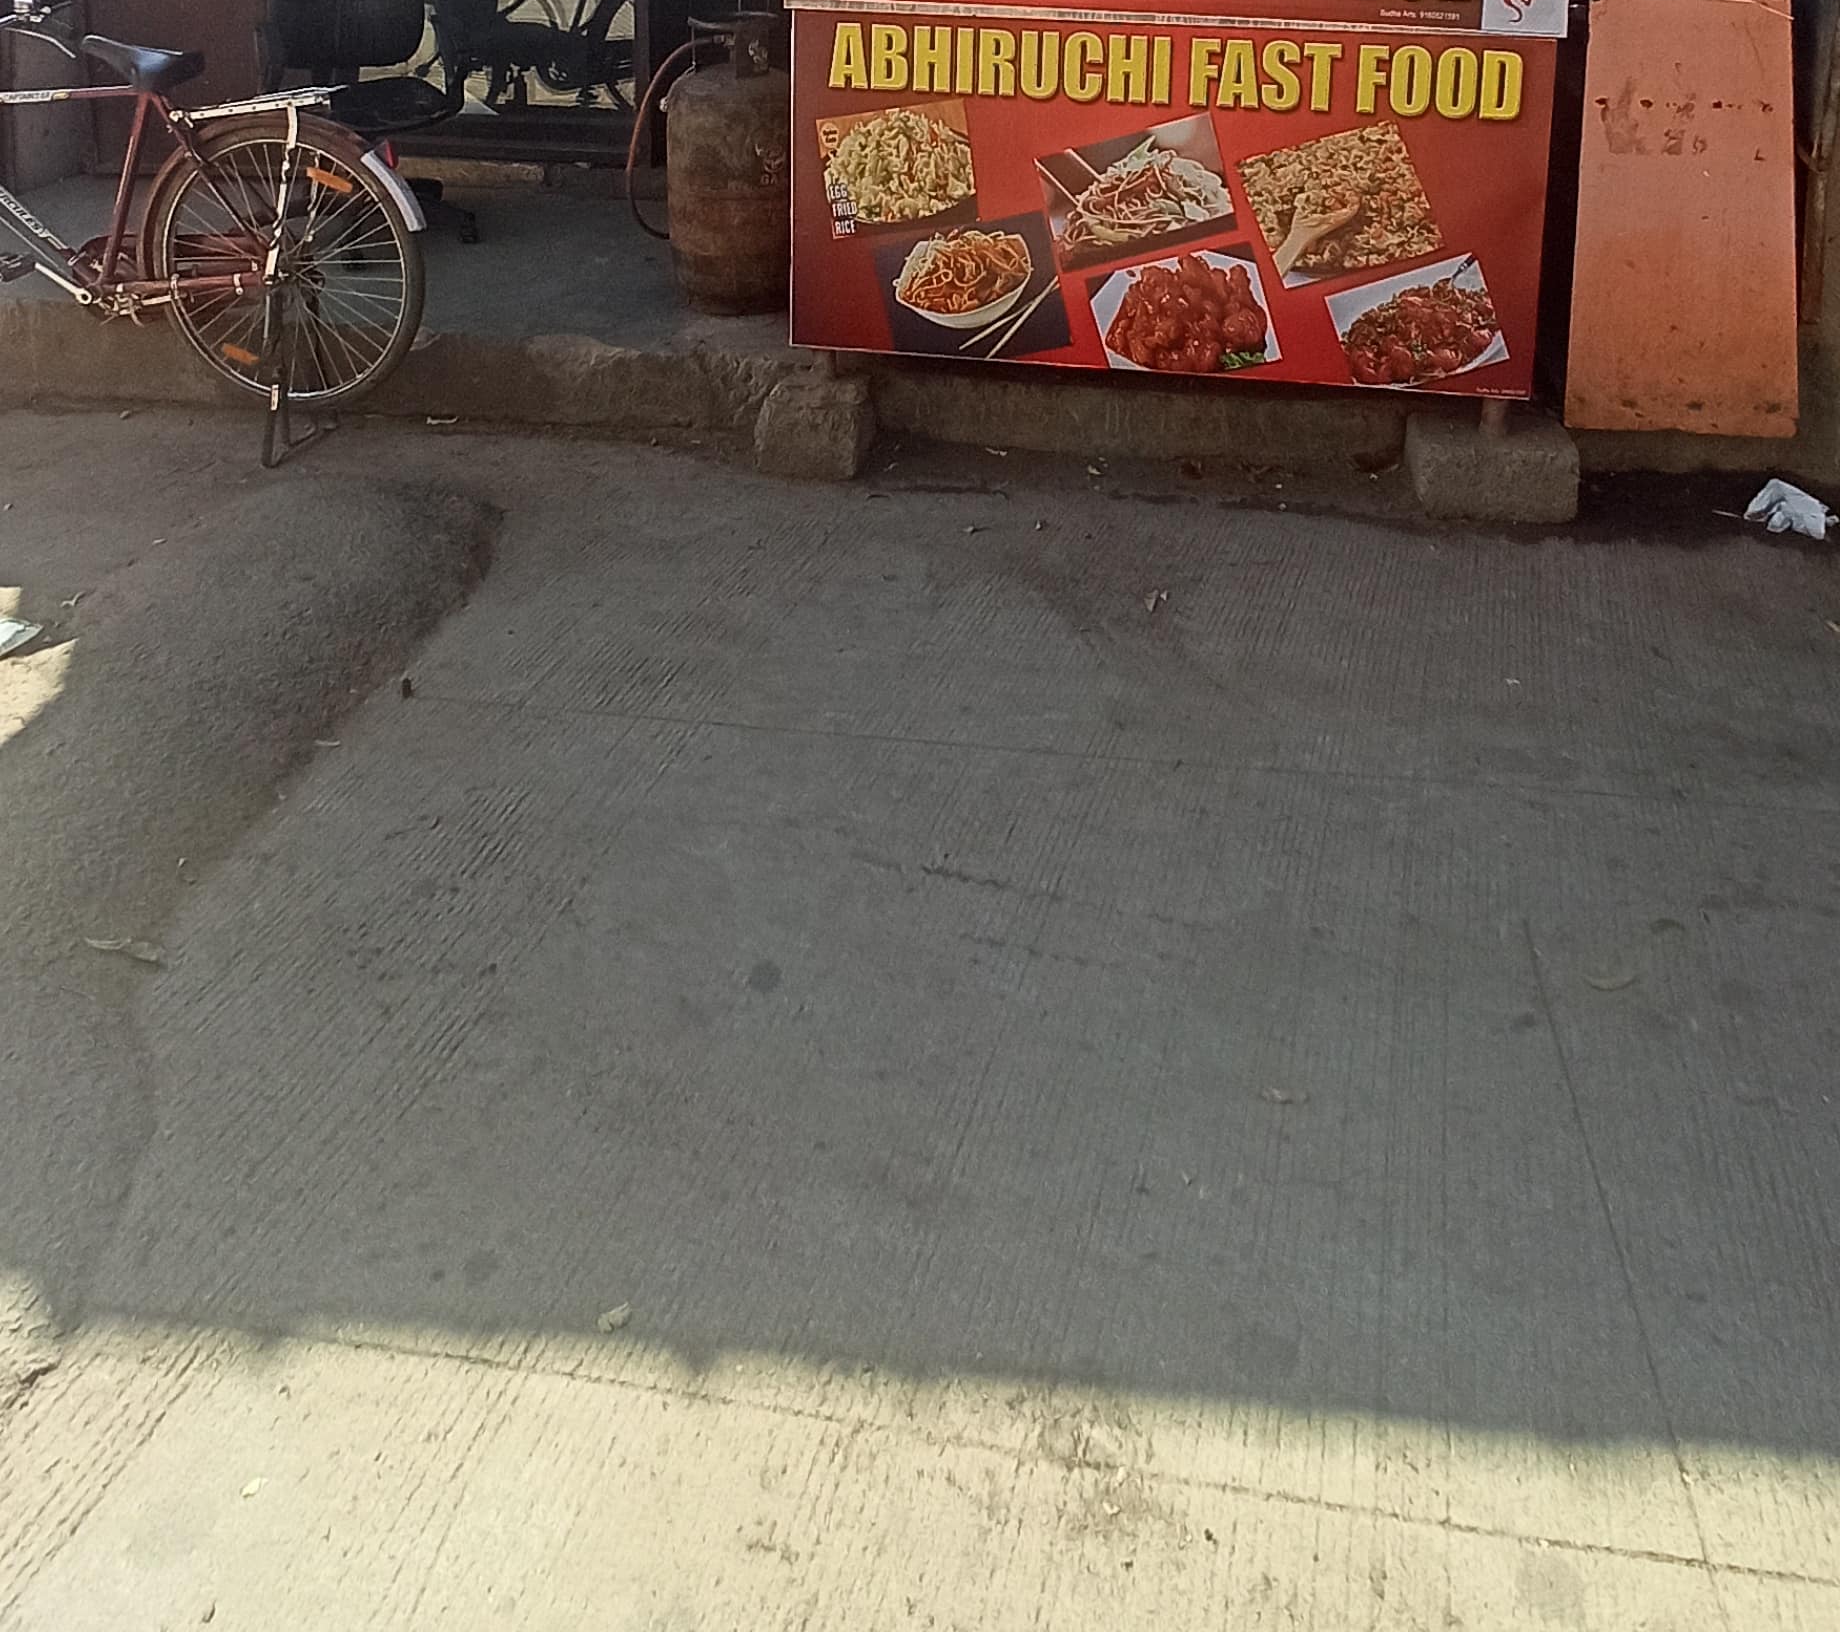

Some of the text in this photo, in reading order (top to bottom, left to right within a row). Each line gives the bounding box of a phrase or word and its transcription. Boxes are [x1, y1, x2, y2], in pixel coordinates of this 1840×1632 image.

[829, 22, 1524, 121] ABHIRUCHI FAST FOOD
[829, 185, 848, 199] EGG
[832, 202, 857, 217] FRIED
[834, 220, 857, 235] RICE
